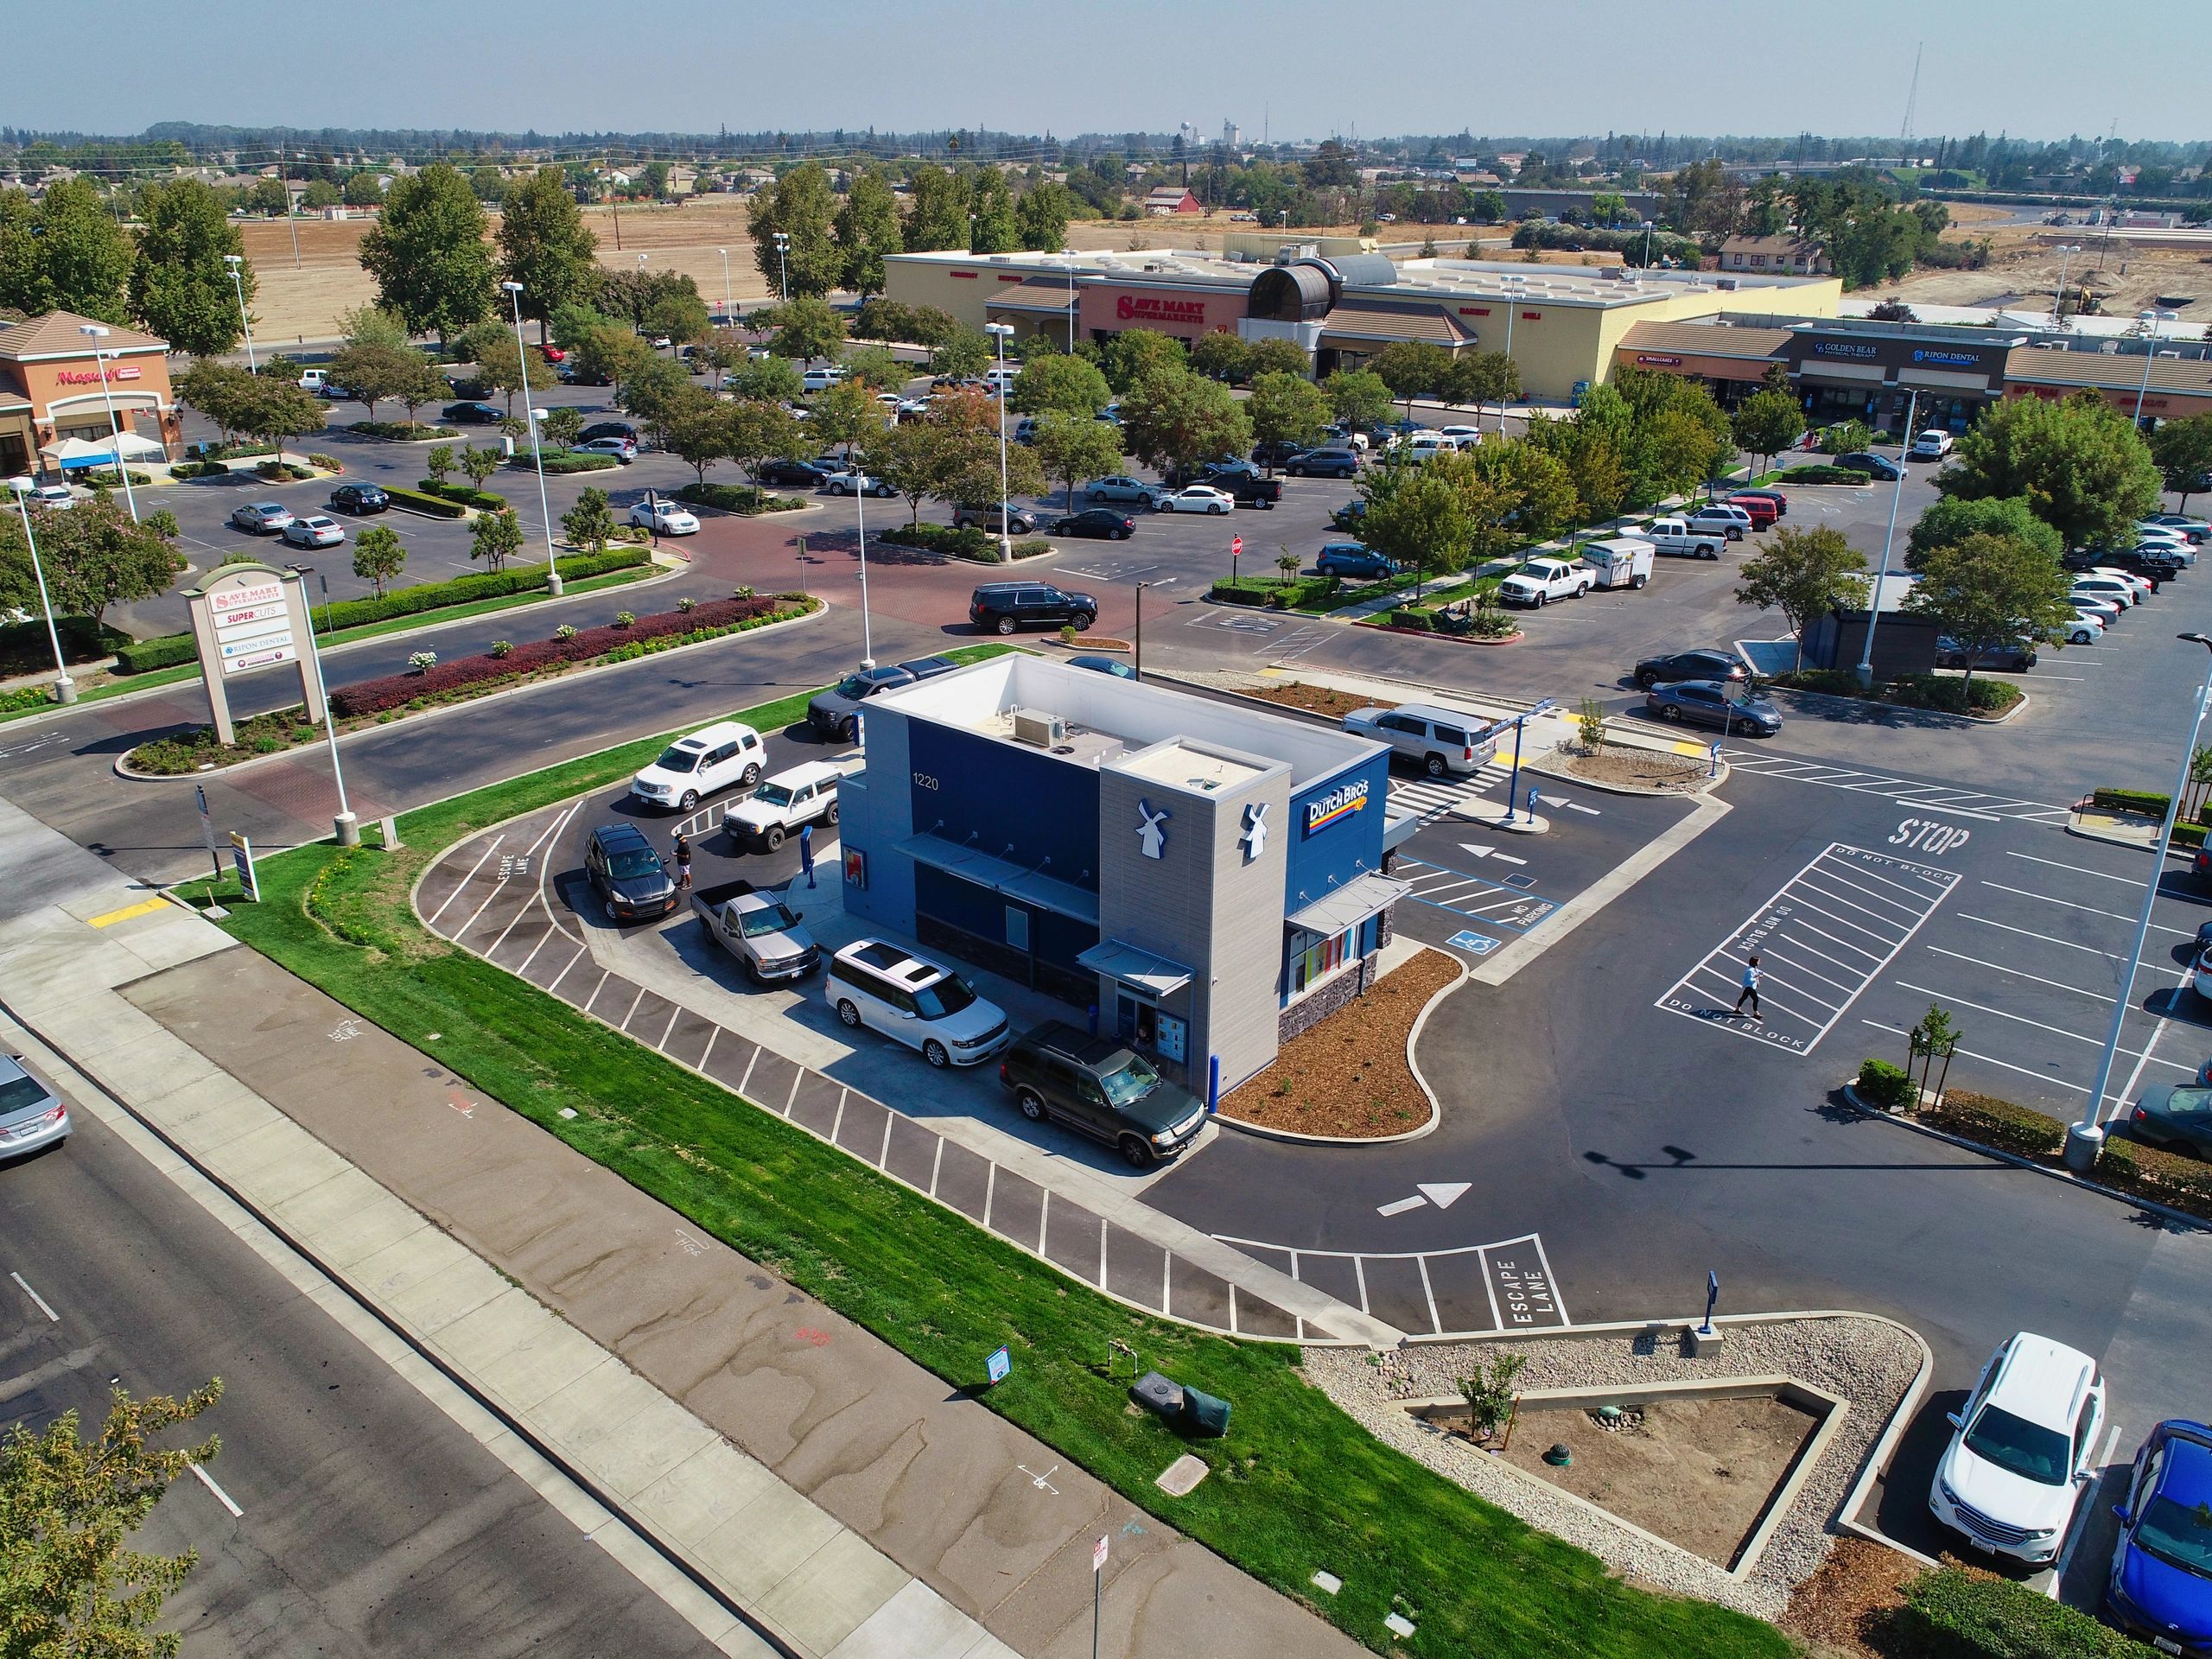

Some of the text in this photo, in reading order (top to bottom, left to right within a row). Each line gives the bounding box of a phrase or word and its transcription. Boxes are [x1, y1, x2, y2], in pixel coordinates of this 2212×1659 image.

[1162, 301, 1205, 314] MART
[1825, 343, 1877, 354] GOLDEN BEAR
[1924, 351, 1948, 359] RIPON
[1949, 353, 1980, 362] DENTAL
[216, 587, 277, 608] SAVE MART
[227, 607, 276, 623] SUPERCUTS
[233, 636, 289, 652] RIPON DENTAL
[912, 772, 938, 791] 1220
[1309, 791, 1343, 822] DUTCH
[1344, 780, 1369, 804] BROS
[1888, 818, 1970, 855] STOP
[497, 855, 515, 880] ESCAPE
[513, 858, 530, 875] LANE
[1835, 847, 1955, 882] DO NOT BLOCK
[1510, 905, 1529, 914] NO
[1516, 903, 1554, 926] PARKING
[1737, 906, 1793, 951] DO NOT BLOCK
[1669, 999, 1804, 1048] DO NOT BLOCK
[1497, 1261, 1534, 1323] ESCAPE
[1523, 1271, 1554, 1313] LANE
